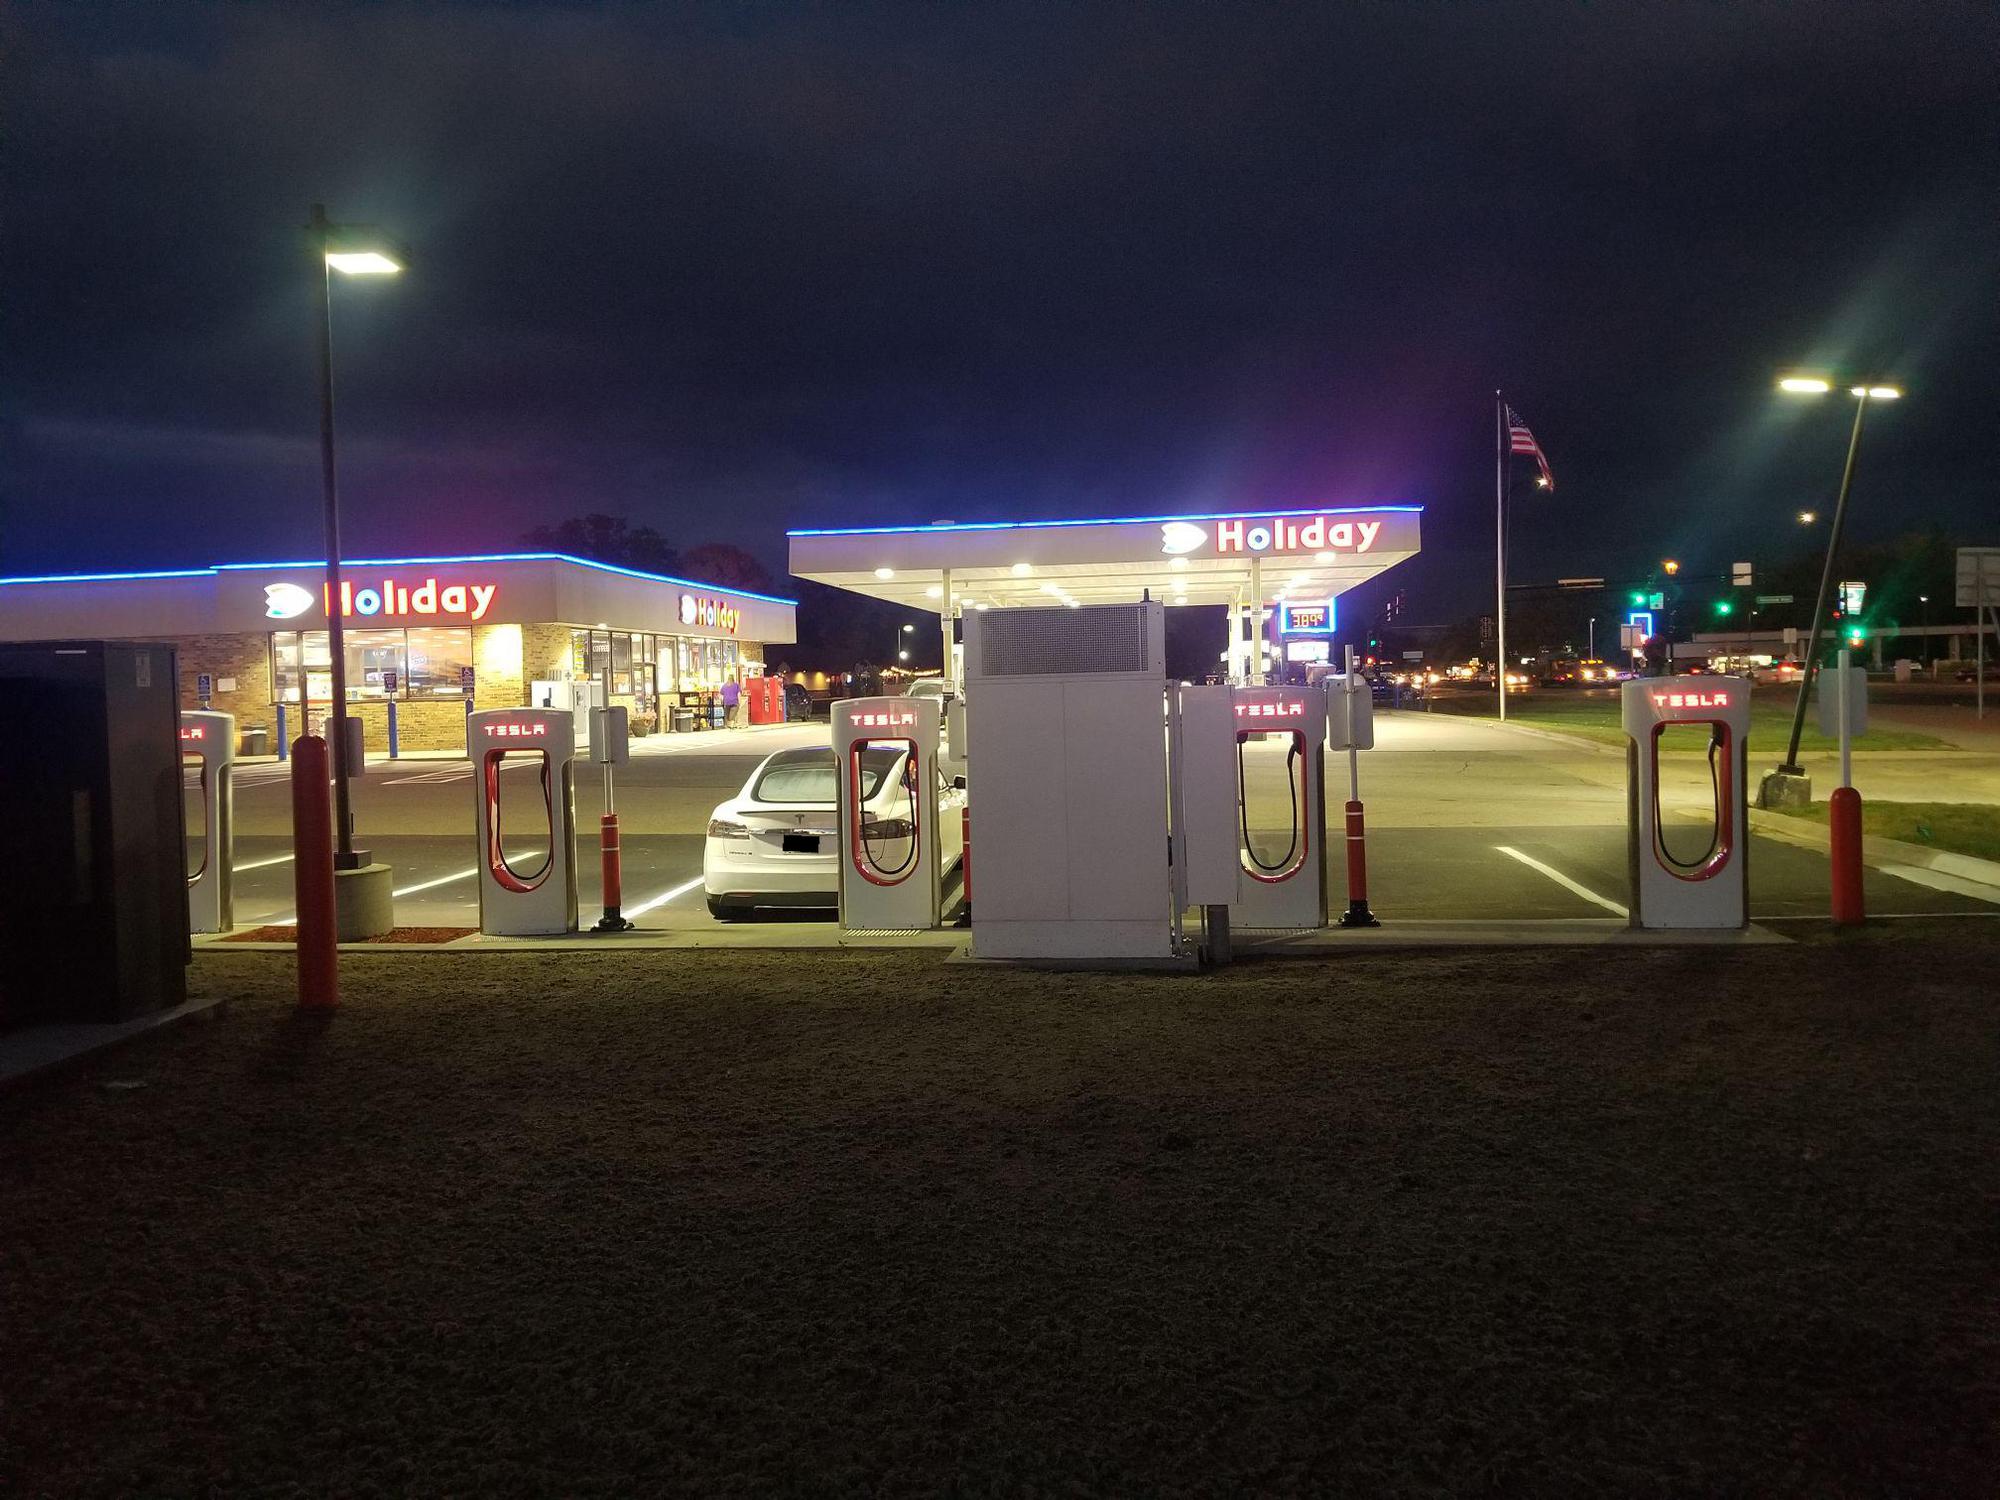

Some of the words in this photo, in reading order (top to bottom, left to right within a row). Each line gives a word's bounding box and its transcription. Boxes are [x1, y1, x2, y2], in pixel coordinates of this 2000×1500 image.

[1217, 517, 1381, 553] Holiday
[698, 598, 740, 636] Holiday
[1653, 694, 1727, 706] TESLA
[1235, 703, 1302, 716] TESLA
[850, 714, 913, 726] TESLA
[484, 725, 545, 736] TESLA
